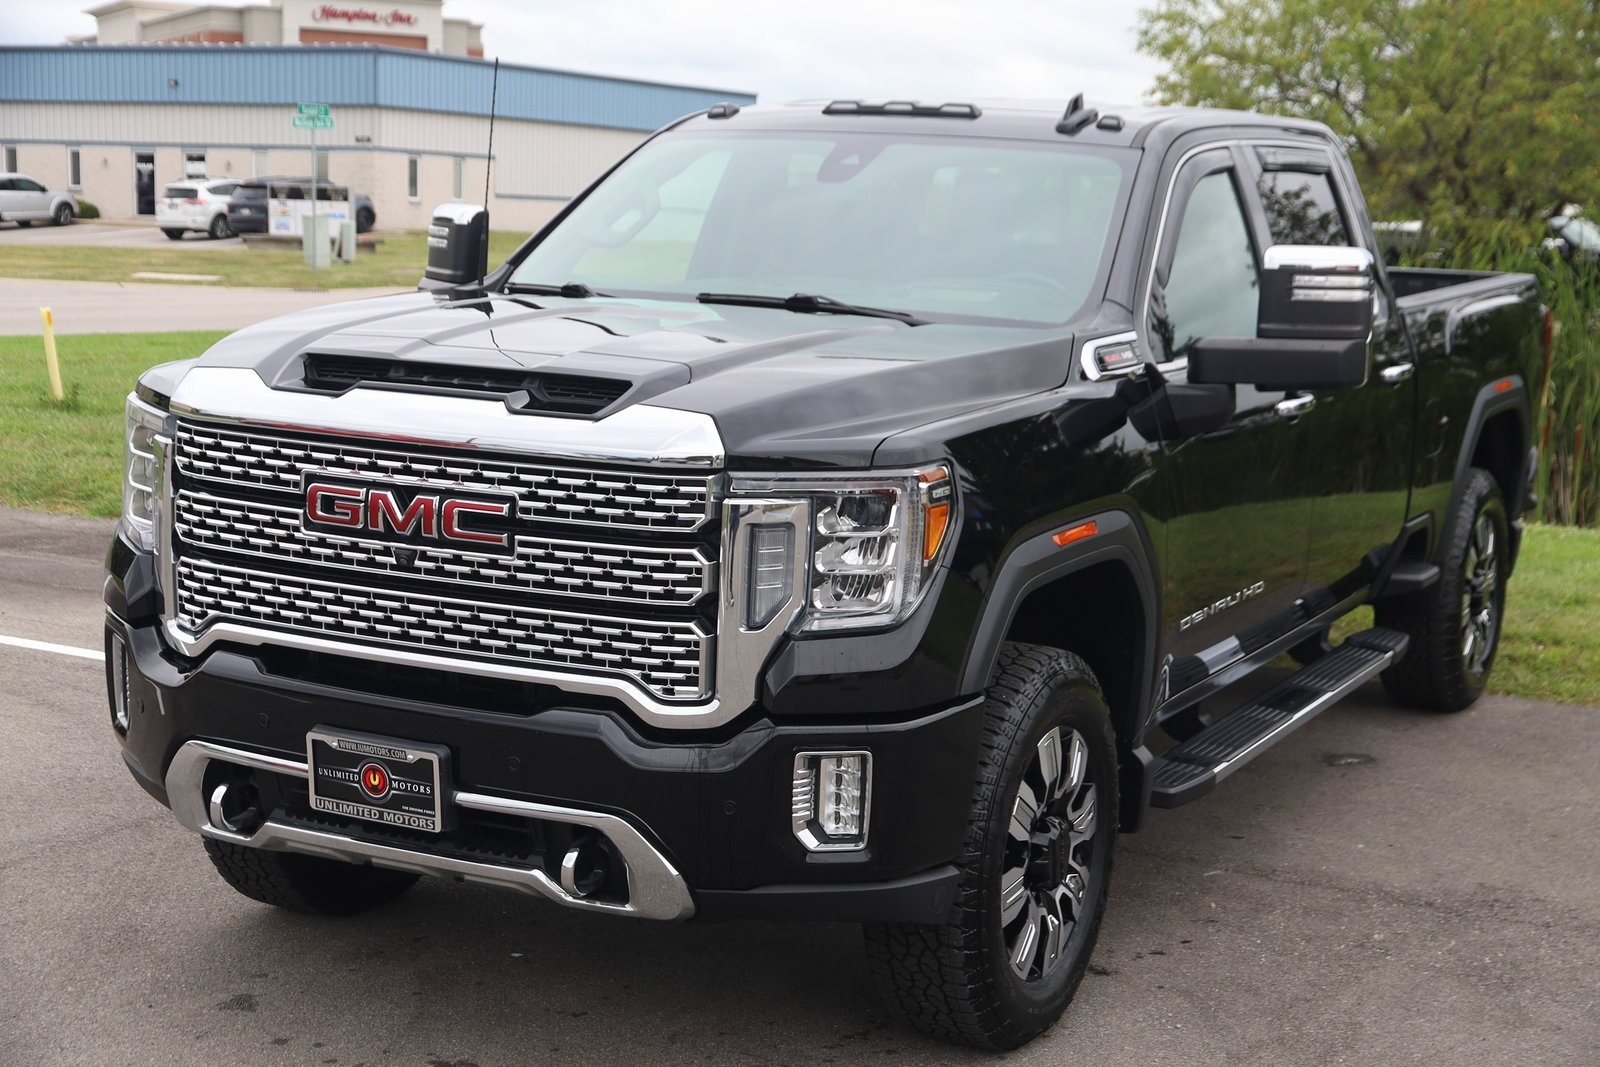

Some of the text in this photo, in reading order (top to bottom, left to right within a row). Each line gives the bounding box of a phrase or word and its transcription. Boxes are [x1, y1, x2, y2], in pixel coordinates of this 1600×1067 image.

[312, 5, 418, 26] Hampton Inn
[307, 482, 510, 547] GMC
[1180, 580, 1265, 633] DENALI HD
[318, 767, 359, 781] UNLIMITED
[391, 780, 431, 794] MOTORS
[316, 798, 434, 830] UNLIMITED MOTORS
